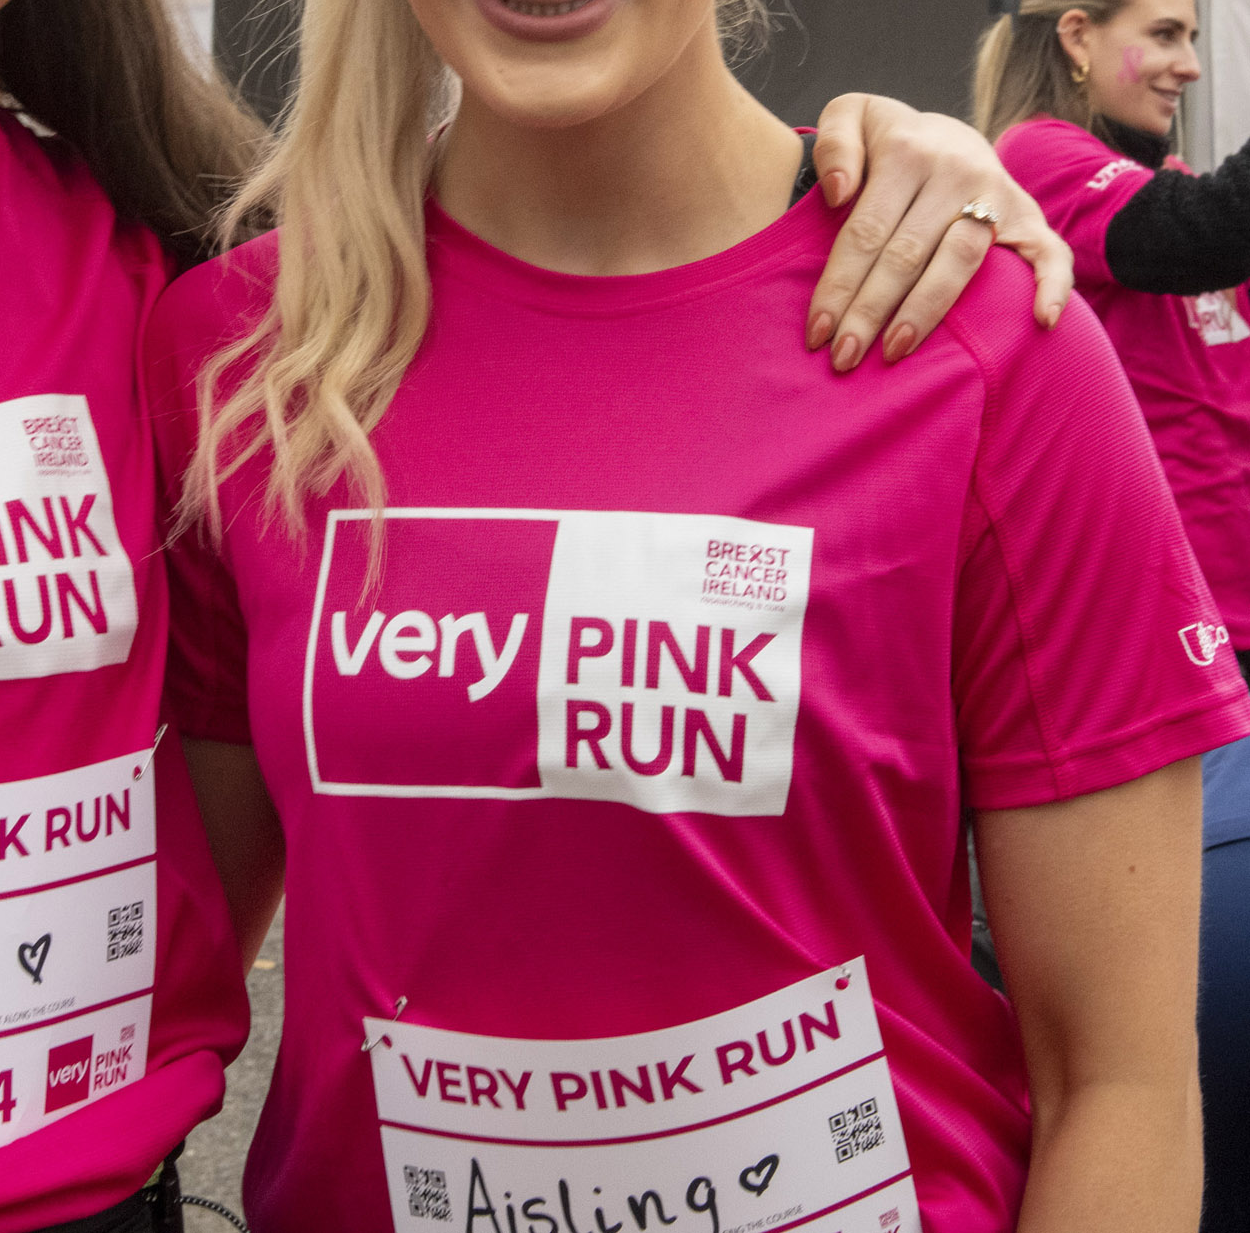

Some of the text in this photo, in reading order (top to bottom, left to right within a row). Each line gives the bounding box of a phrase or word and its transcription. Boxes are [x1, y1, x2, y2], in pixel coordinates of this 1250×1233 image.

[702, 578, 787, 602] IRELAND
[705, 560, 788, 585] CANCER
[331, 609, 529, 703] very
[565, 615, 778, 702] PINK
[565, 698, 748, 783] RUN
[44, 787, 132, 854] RUN
[49, 1057, 90, 1088] very
[93, 1063, 128, 1091] RUN
[95, 1043, 134, 1072] PINK
[400, 999, 842, 1112] VERY PINK RUN
[465, 1156, 721, 1233] Aisling
